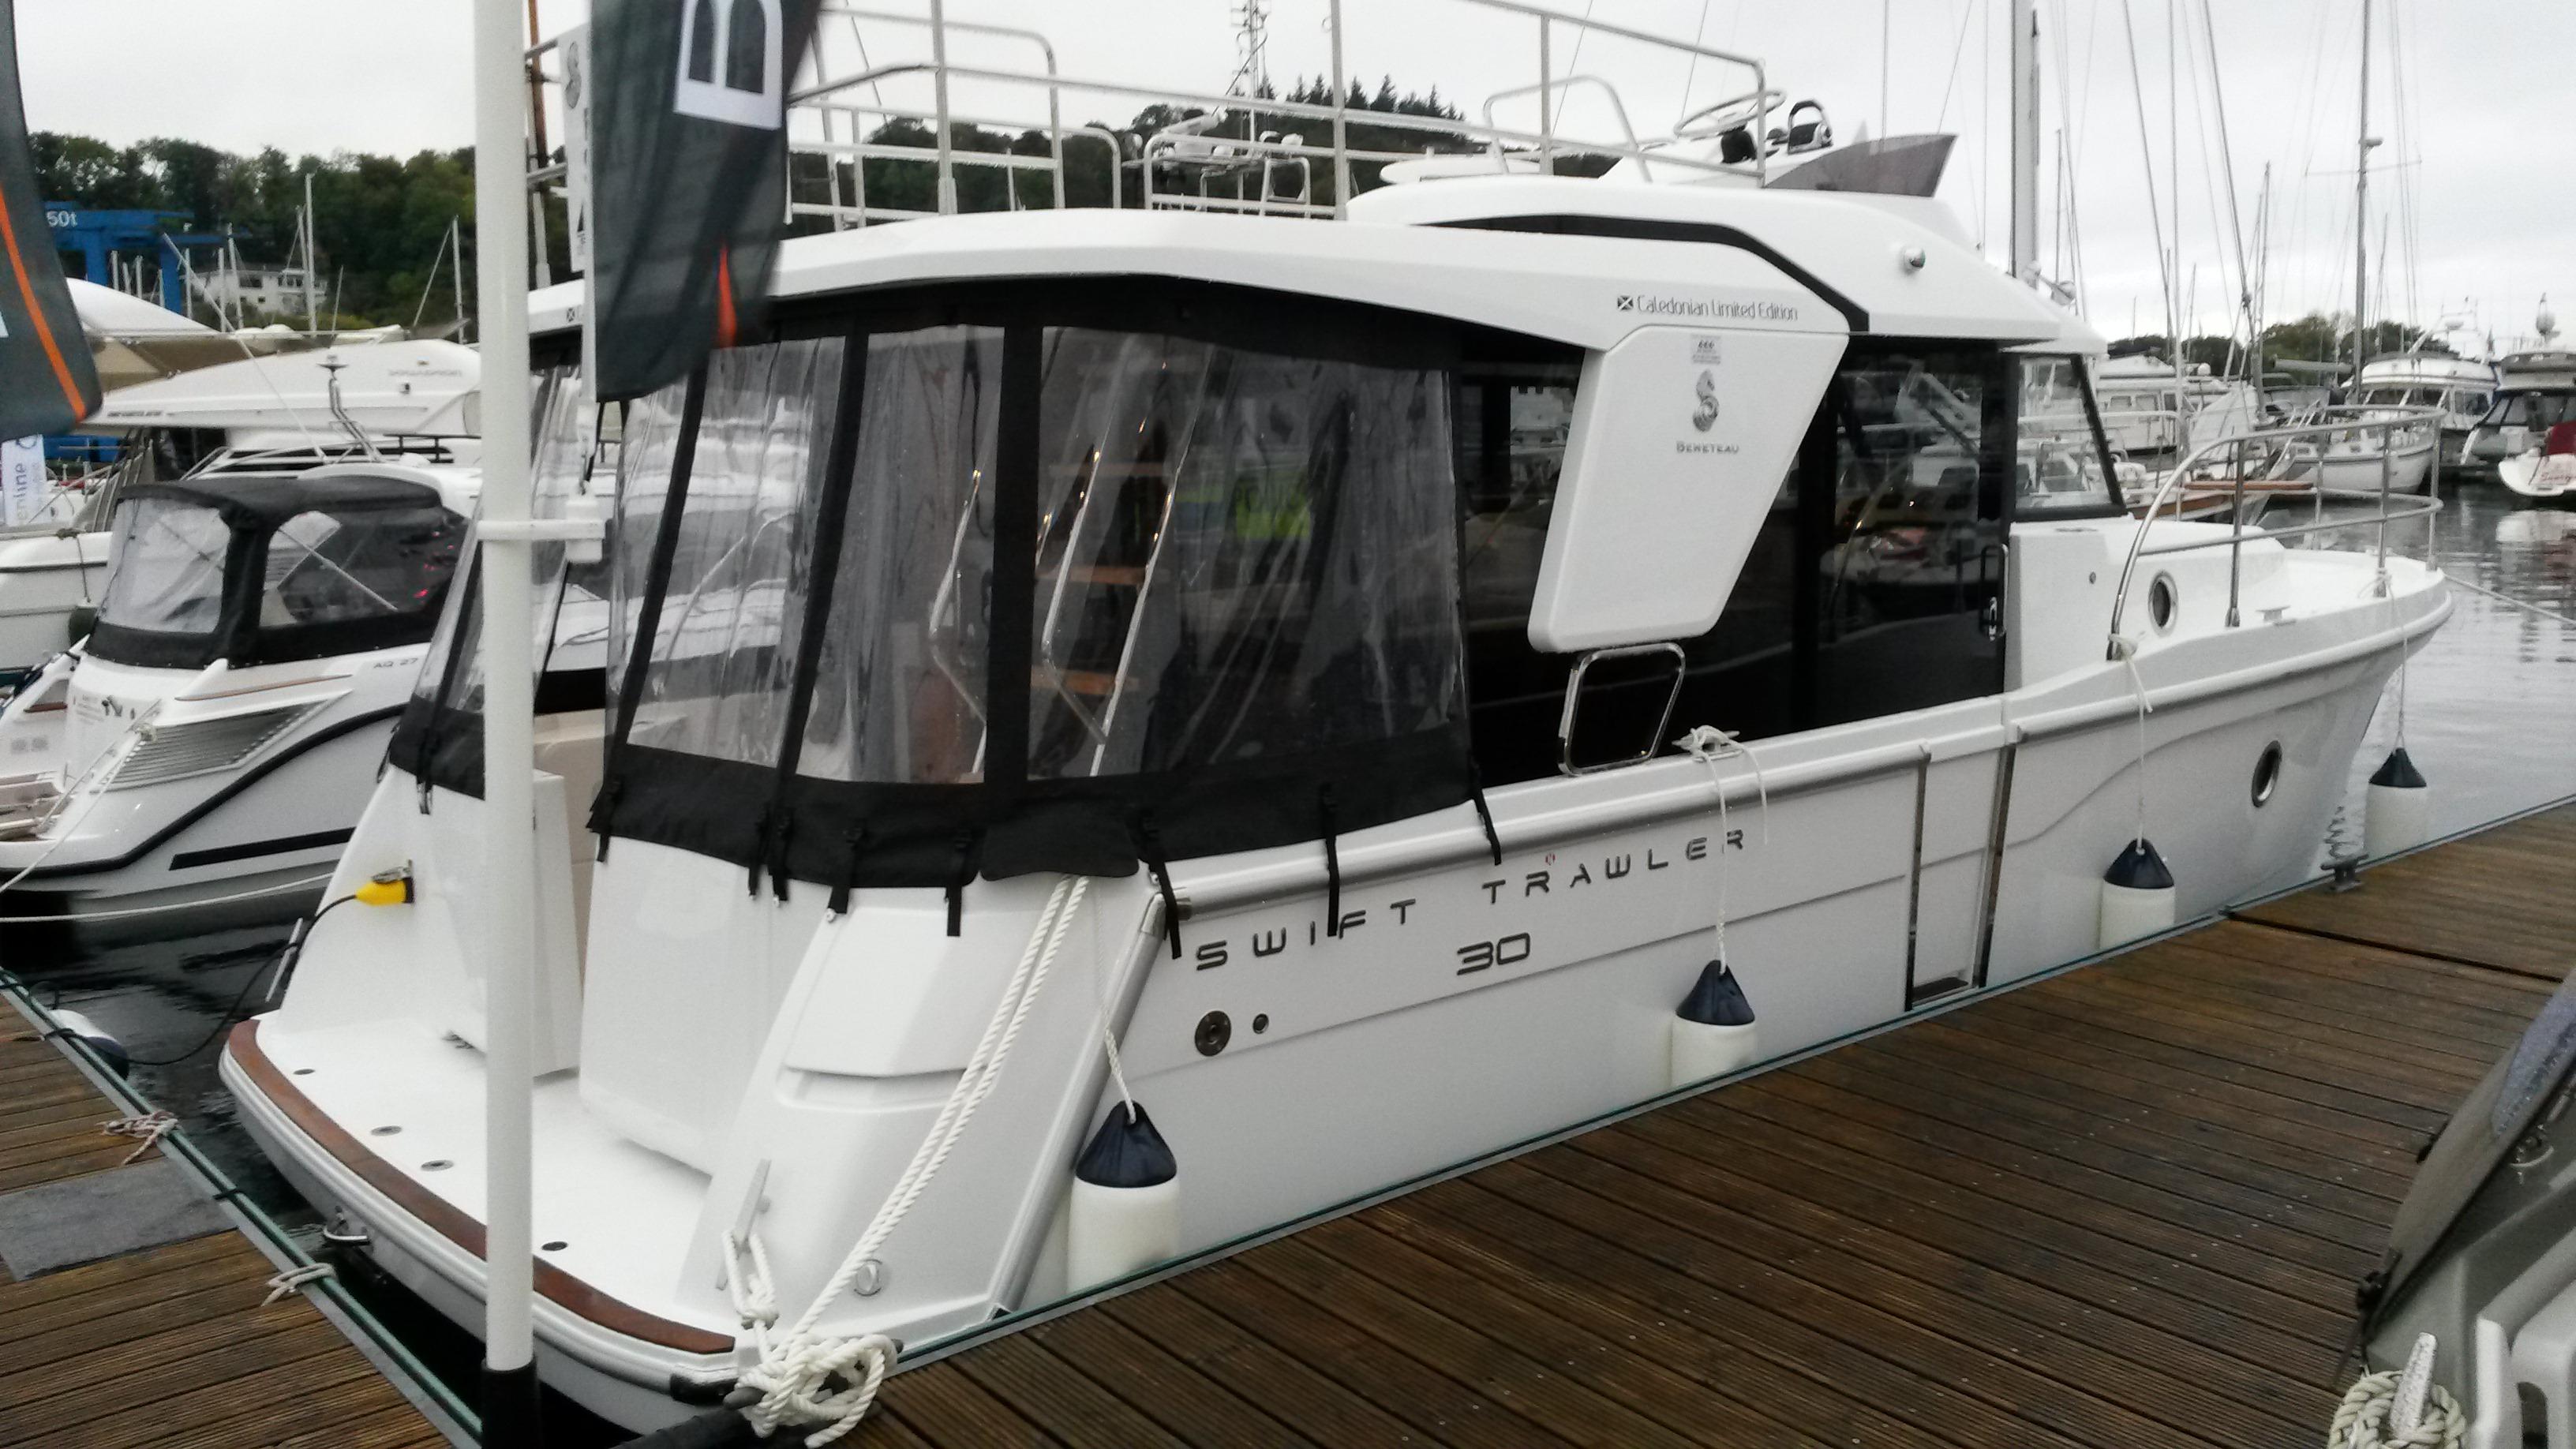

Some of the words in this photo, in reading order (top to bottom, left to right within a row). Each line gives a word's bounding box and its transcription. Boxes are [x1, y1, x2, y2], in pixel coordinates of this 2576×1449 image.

[1637, 295, 1709, 316] Caledonian
[1712, 298, 1756, 320] Limited
[1758, 298, 1798, 321] Edition
[1196, 898, 1417, 972] SWIFT
[1481, 829, 1744, 905] TRAWLER
[1456, 931, 1531, 975] 30
